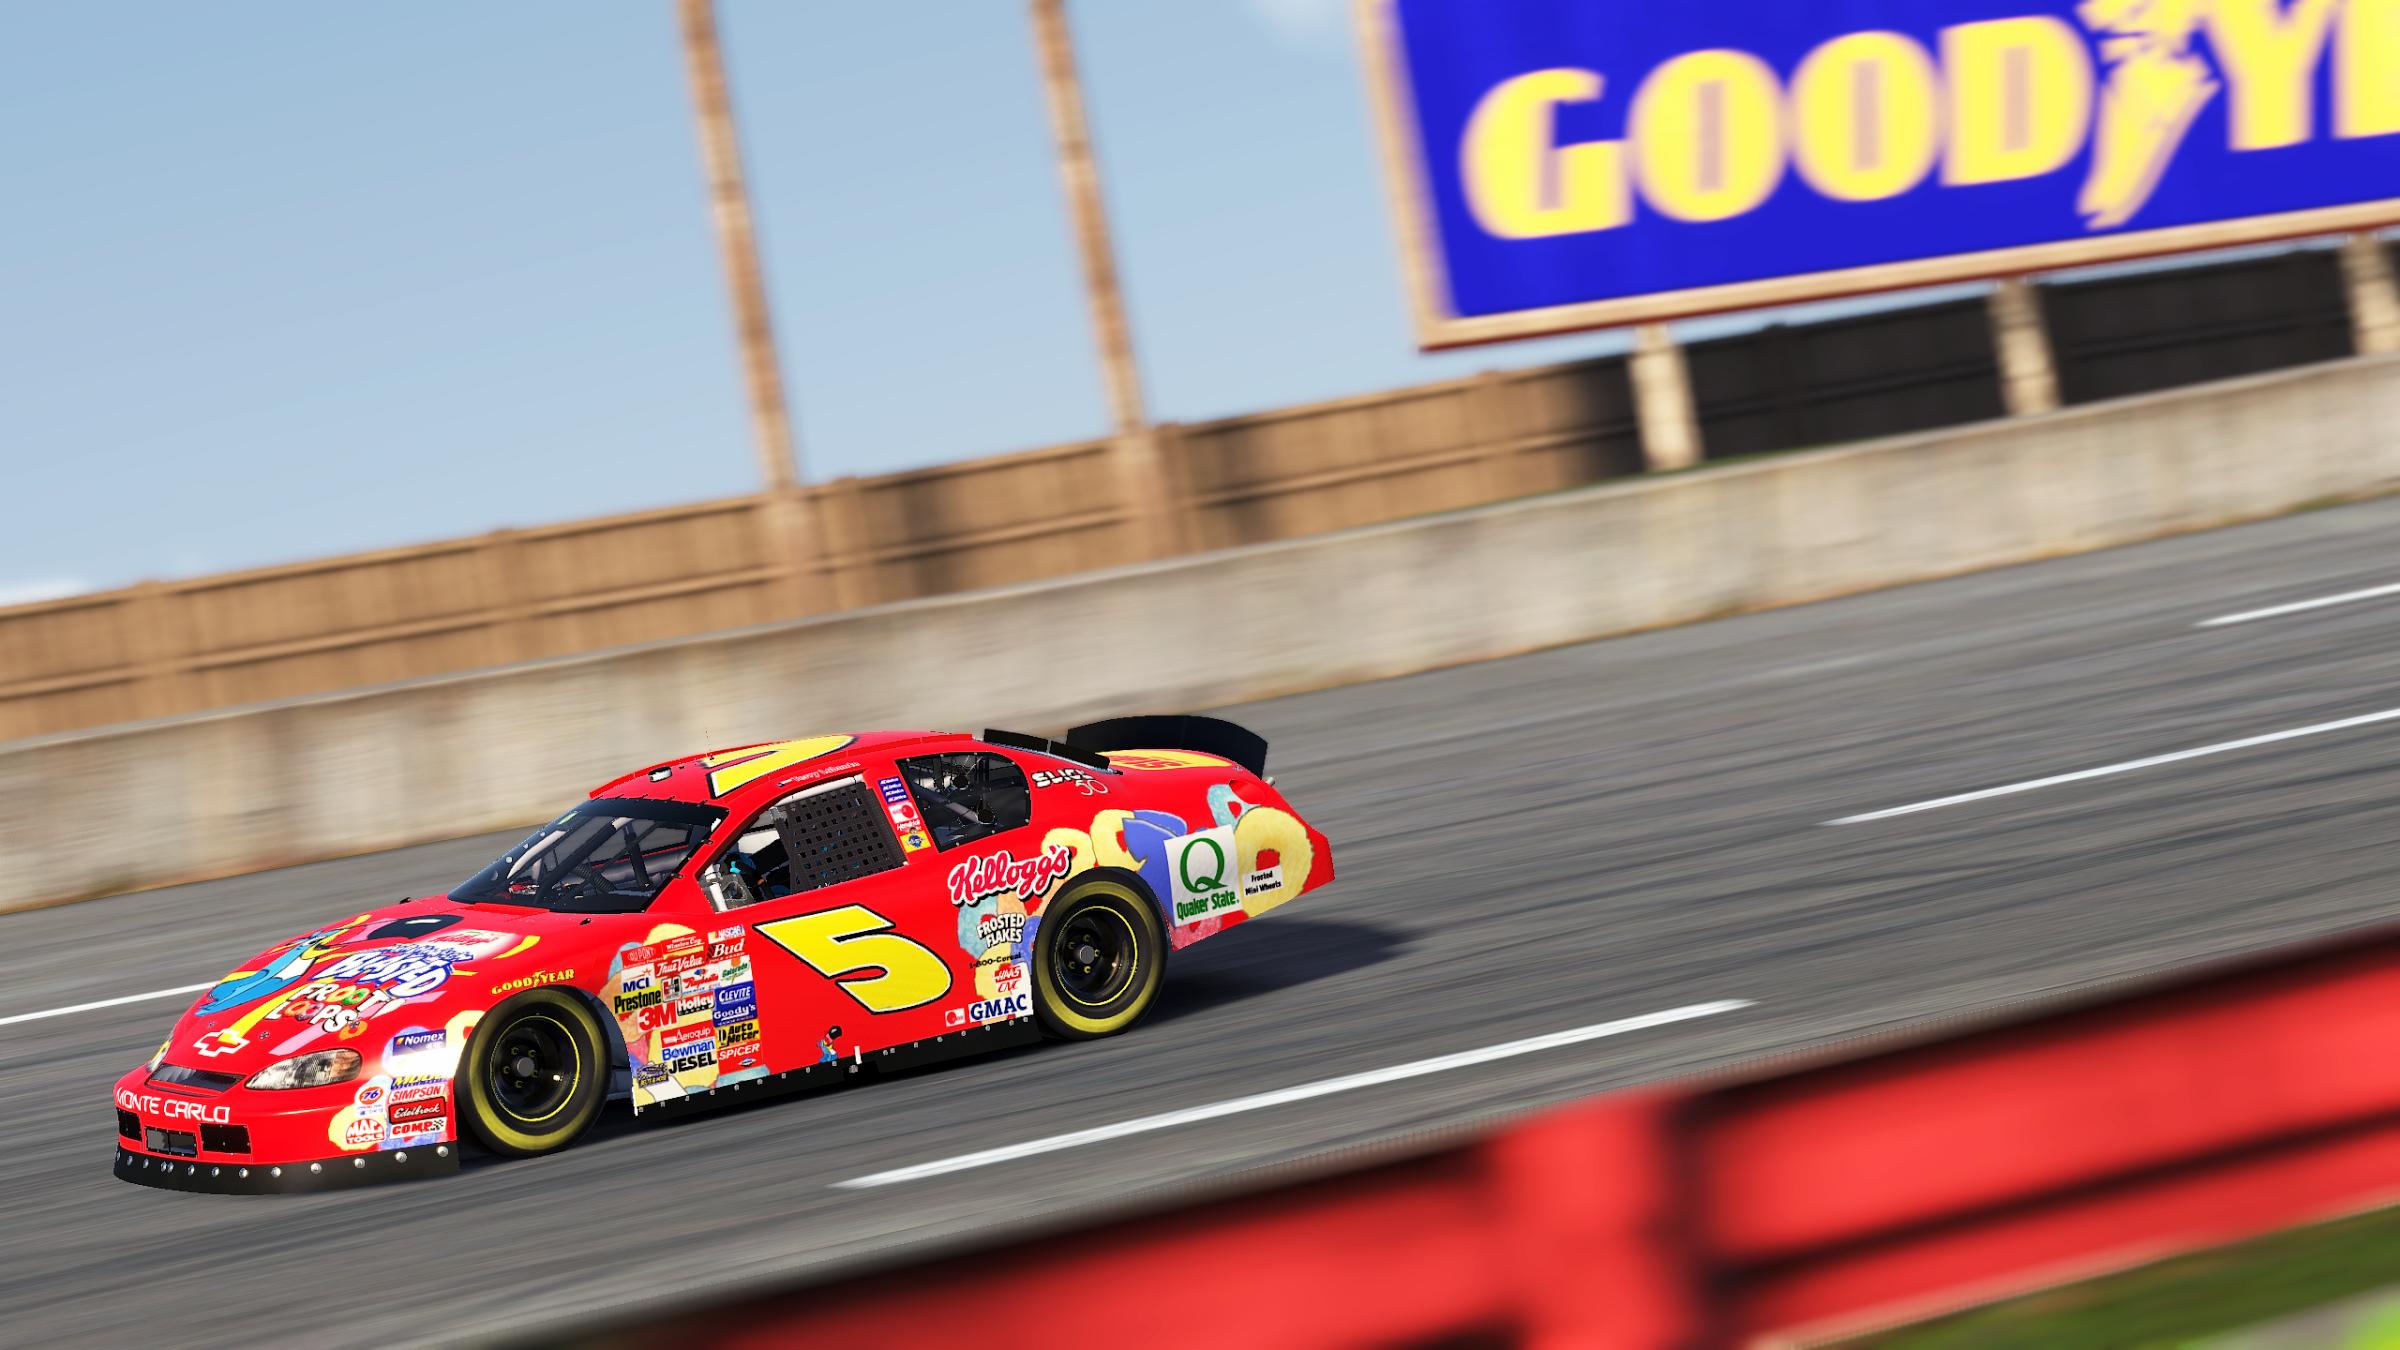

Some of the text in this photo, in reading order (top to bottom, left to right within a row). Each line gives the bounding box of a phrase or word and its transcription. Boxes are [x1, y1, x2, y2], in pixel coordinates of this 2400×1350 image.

[1075, 779, 1109, 796] 50
[948, 844, 1070, 904] Kellogg's
[1180, 837, 1228, 894] Q
[1251, 871, 1273, 882] Frosted
[1176, 897, 1209, 921] Quaker
[977, 913, 1026, 939] FROSTED
[986, 928, 1023, 948] FLAKES
[713, 938, 745, 958] Bud
[752, 902, 954, 1015] 5
[491, 968, 575, 995] GOODYEAR
[623, 977, 650, 993] MCI
[287, 981, 391, 1013] FROOT
[614, 989, 662, 1014] Prestone
[678, 994, 715, 1011] Holley
[718, 986, 752, 1003] CLEVITE
[639, 1001, 678, 1031] 3M
[713, 1003, 757, 1021] Goody's
[970, 994, 1027, 1021] GMAC
[264, 1001, 360, 1033] LOOPS
[675, 1027, 712, 1042] Aeroquip
[728, 1022, 754, 1035] Auto
[404, 1032, 445, 1046] Nomex
[727, 1030, 760, 1046] Meter
[661, 1040, 715, 1061] Bowman
[719, 1043, 761, 1061] SPICER
[669, 1051, 717, 1074] JESEL
[363, 1089, 379, 1100] 76
[391, 1086, 441, 1102] SIMPSON
[116, 1087, 231, 1124] MONTE CARLO
[393, 1103, 441, 1118] Edelbrock
[348, 1119, 384, 1137] MAC
[392, 1121, 433, 1135] COMP
[347, 1133, 384, 1143] TOOLS
